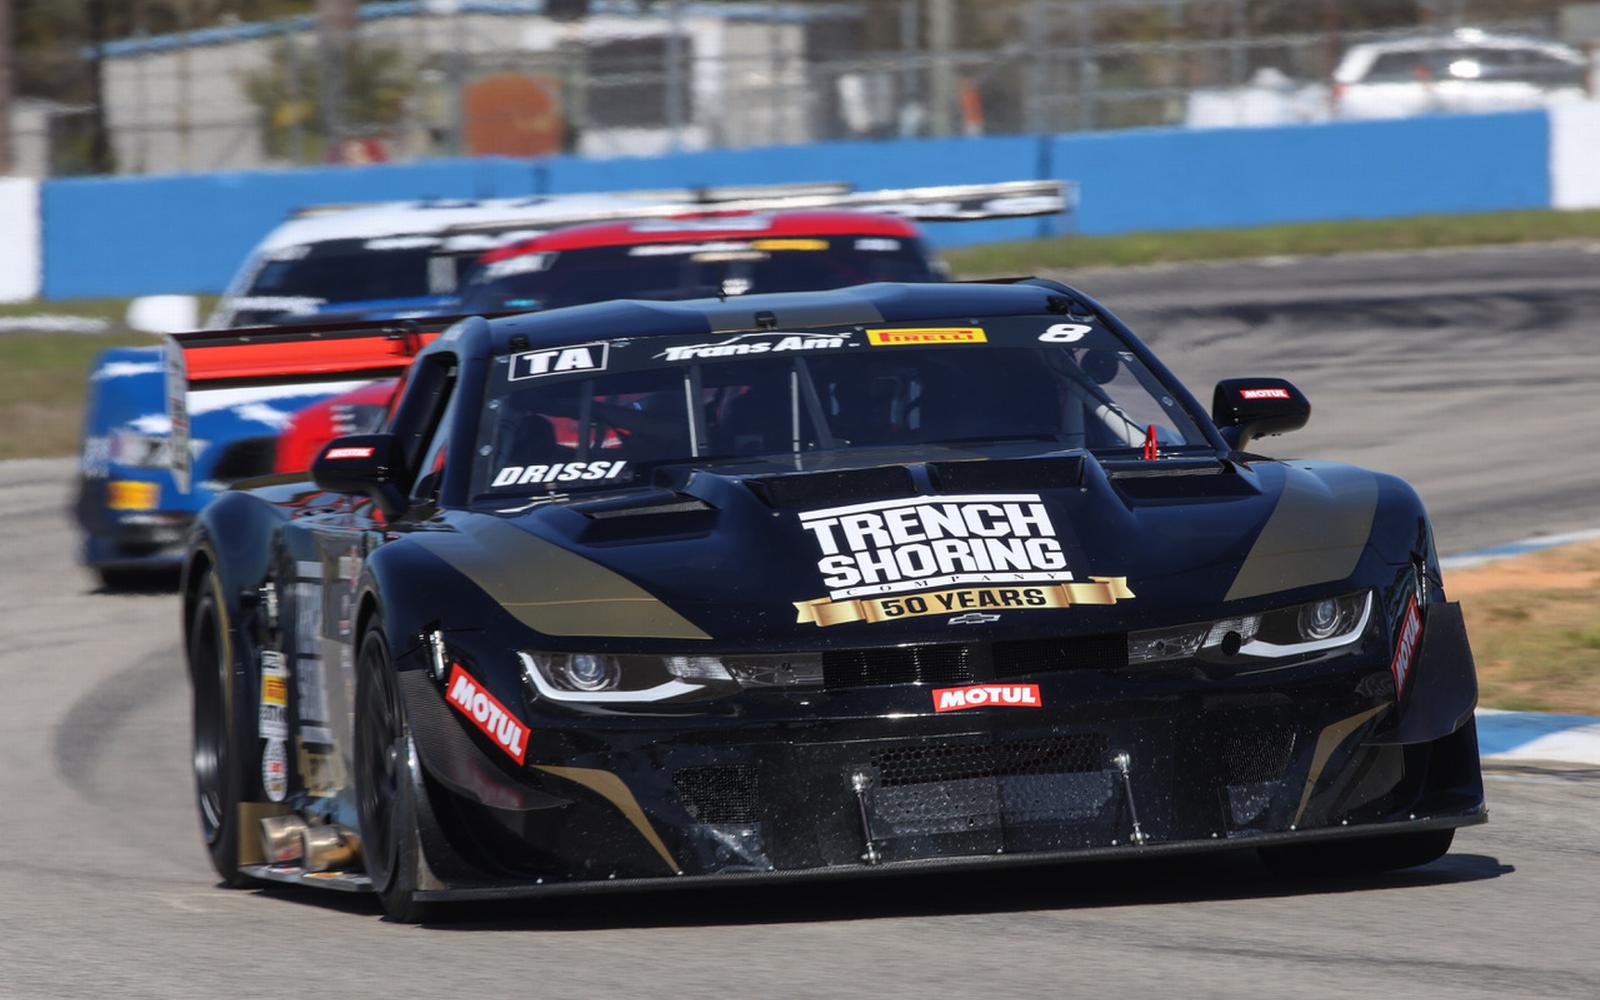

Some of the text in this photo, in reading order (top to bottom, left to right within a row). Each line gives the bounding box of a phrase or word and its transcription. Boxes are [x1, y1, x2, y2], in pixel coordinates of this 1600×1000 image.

[878, 331, 974, 343] PIRELLI
[1038, 323, 1092, 343] 8
[523, 347, 594, 375] TA
[665, 336, 844, 361] Trans Am
[491, 460, 627, 487] DRISSI
[801, 503, 1056, 556] TRENCH
[817, 538, 1067, 588] SHORING
[846, 573, 1057, 596] COMPANY
[880, 588, 1047, 617] 50 YEARS
[1396, 607, 1420, 686] MOTUL
[940, 687, 1036, 709] MOTUL
[450, 675, 522, 756] MOTUL
